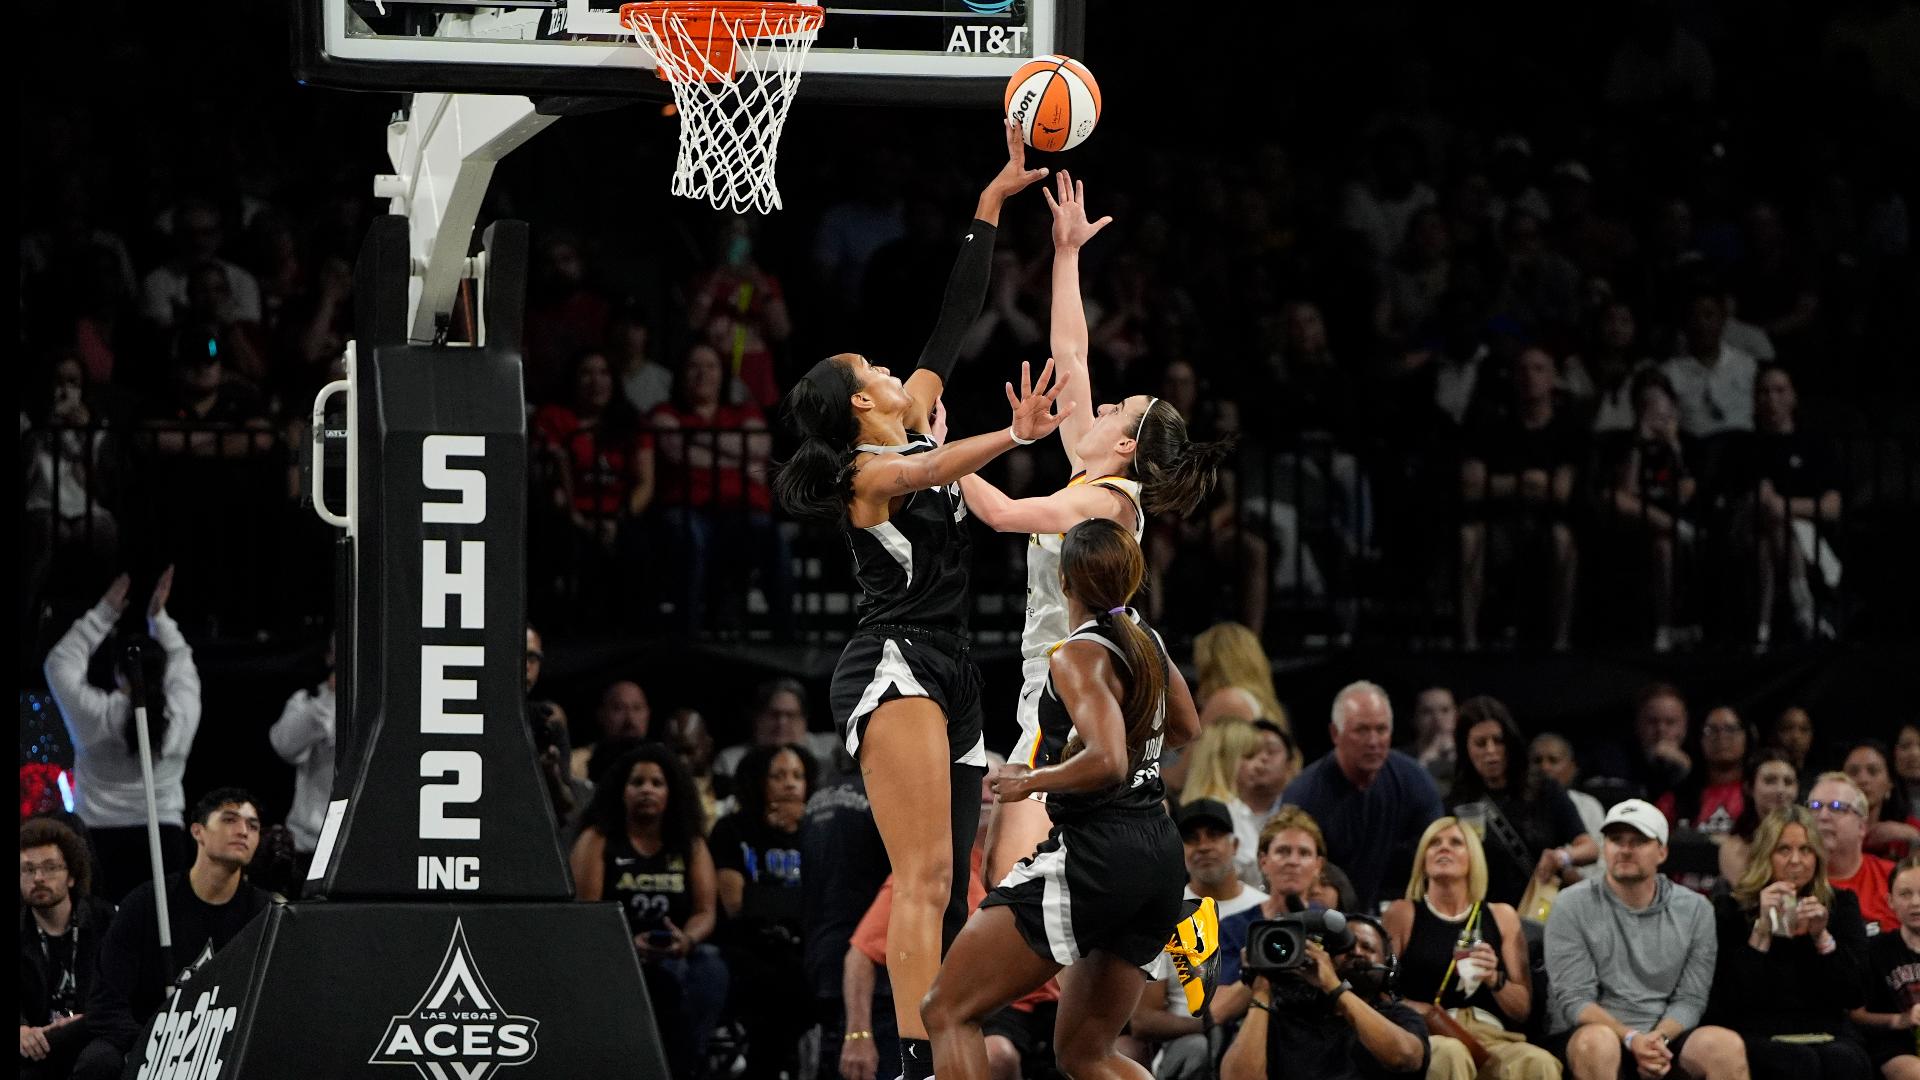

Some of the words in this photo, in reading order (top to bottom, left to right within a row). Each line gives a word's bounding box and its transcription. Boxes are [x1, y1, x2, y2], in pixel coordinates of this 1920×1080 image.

[946, 25, 1028, 54] AT&T
[417, 855, 481, 890] INC
[420, 1011, 447, 1020] LAS
[452, 1011, 498, 1020] VEGAS
[384, 1023, 530, 1057] ACES
